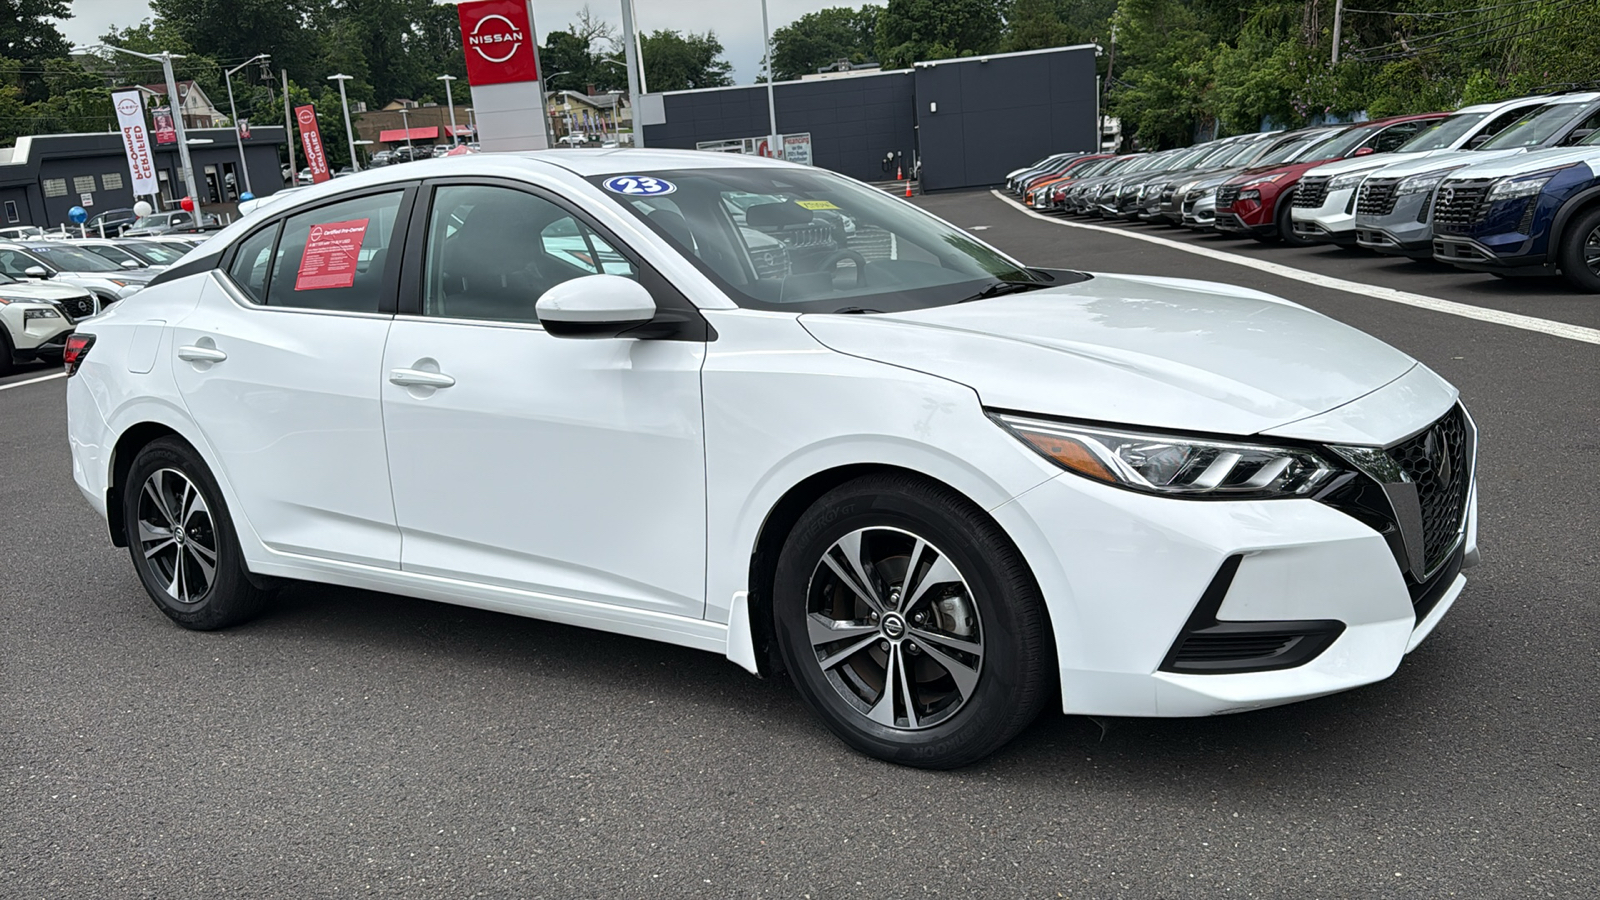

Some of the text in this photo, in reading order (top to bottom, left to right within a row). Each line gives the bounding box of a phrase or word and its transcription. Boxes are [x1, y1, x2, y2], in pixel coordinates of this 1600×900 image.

[469, 32, 523, 45] NISSAN
[616, 178, 662, 193] 23
[841, 504, 856, 514] GT
